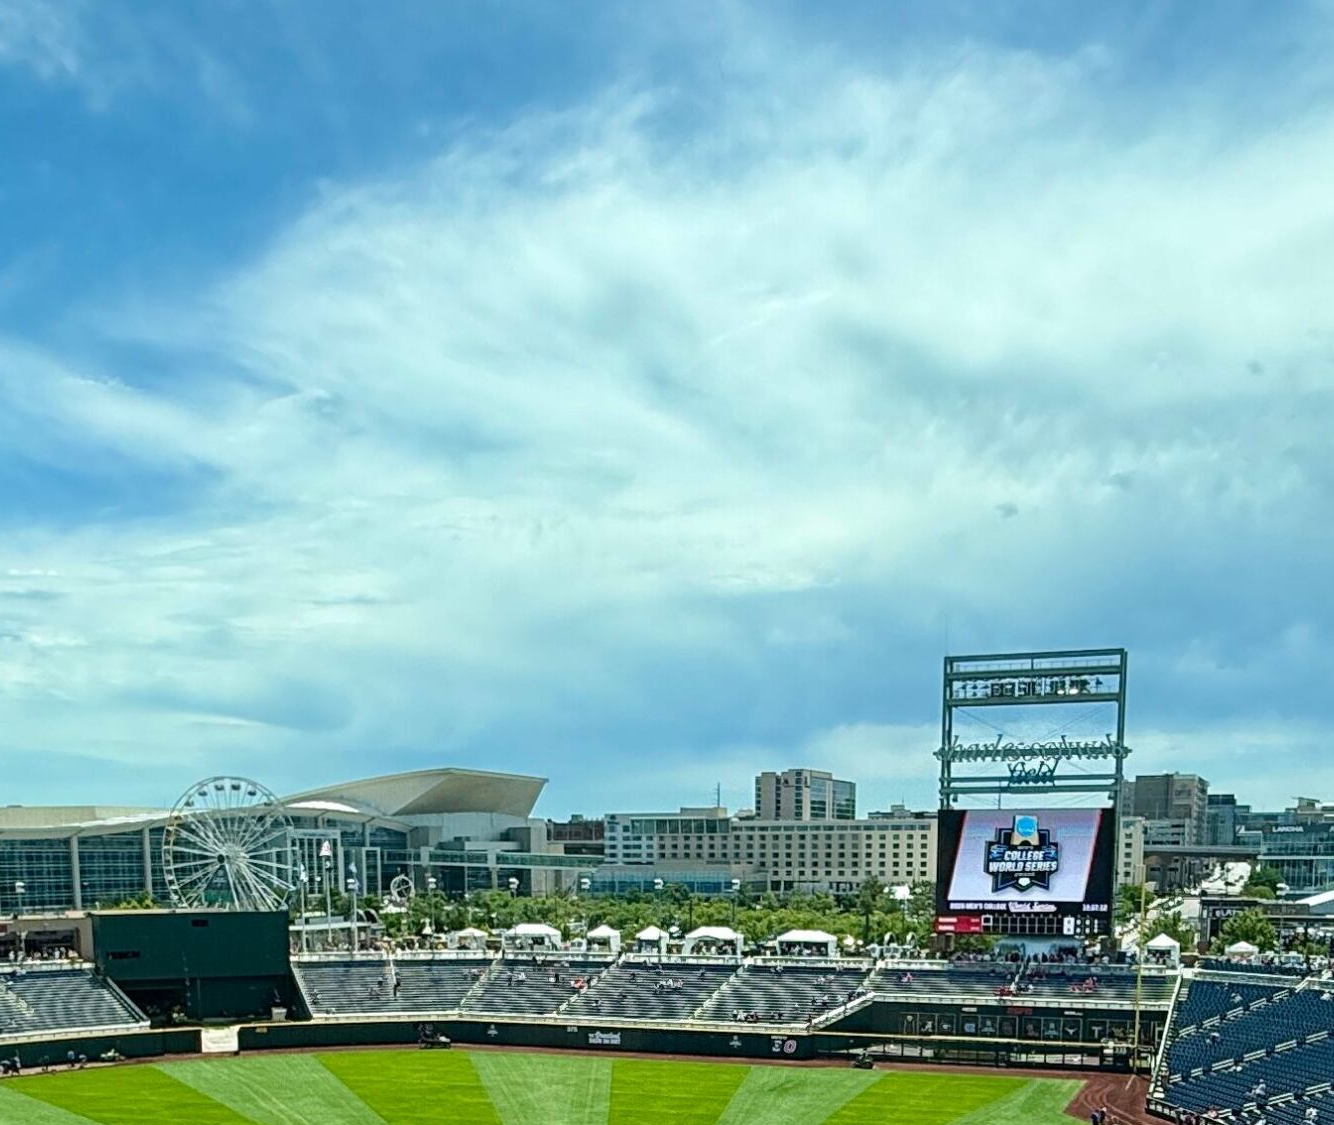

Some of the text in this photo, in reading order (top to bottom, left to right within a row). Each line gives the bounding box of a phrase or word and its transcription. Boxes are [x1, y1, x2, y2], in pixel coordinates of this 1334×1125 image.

[1004, 851, 1045, 861] COLLEGE
[989, 861, 1058, 872] WORLD SERIES
